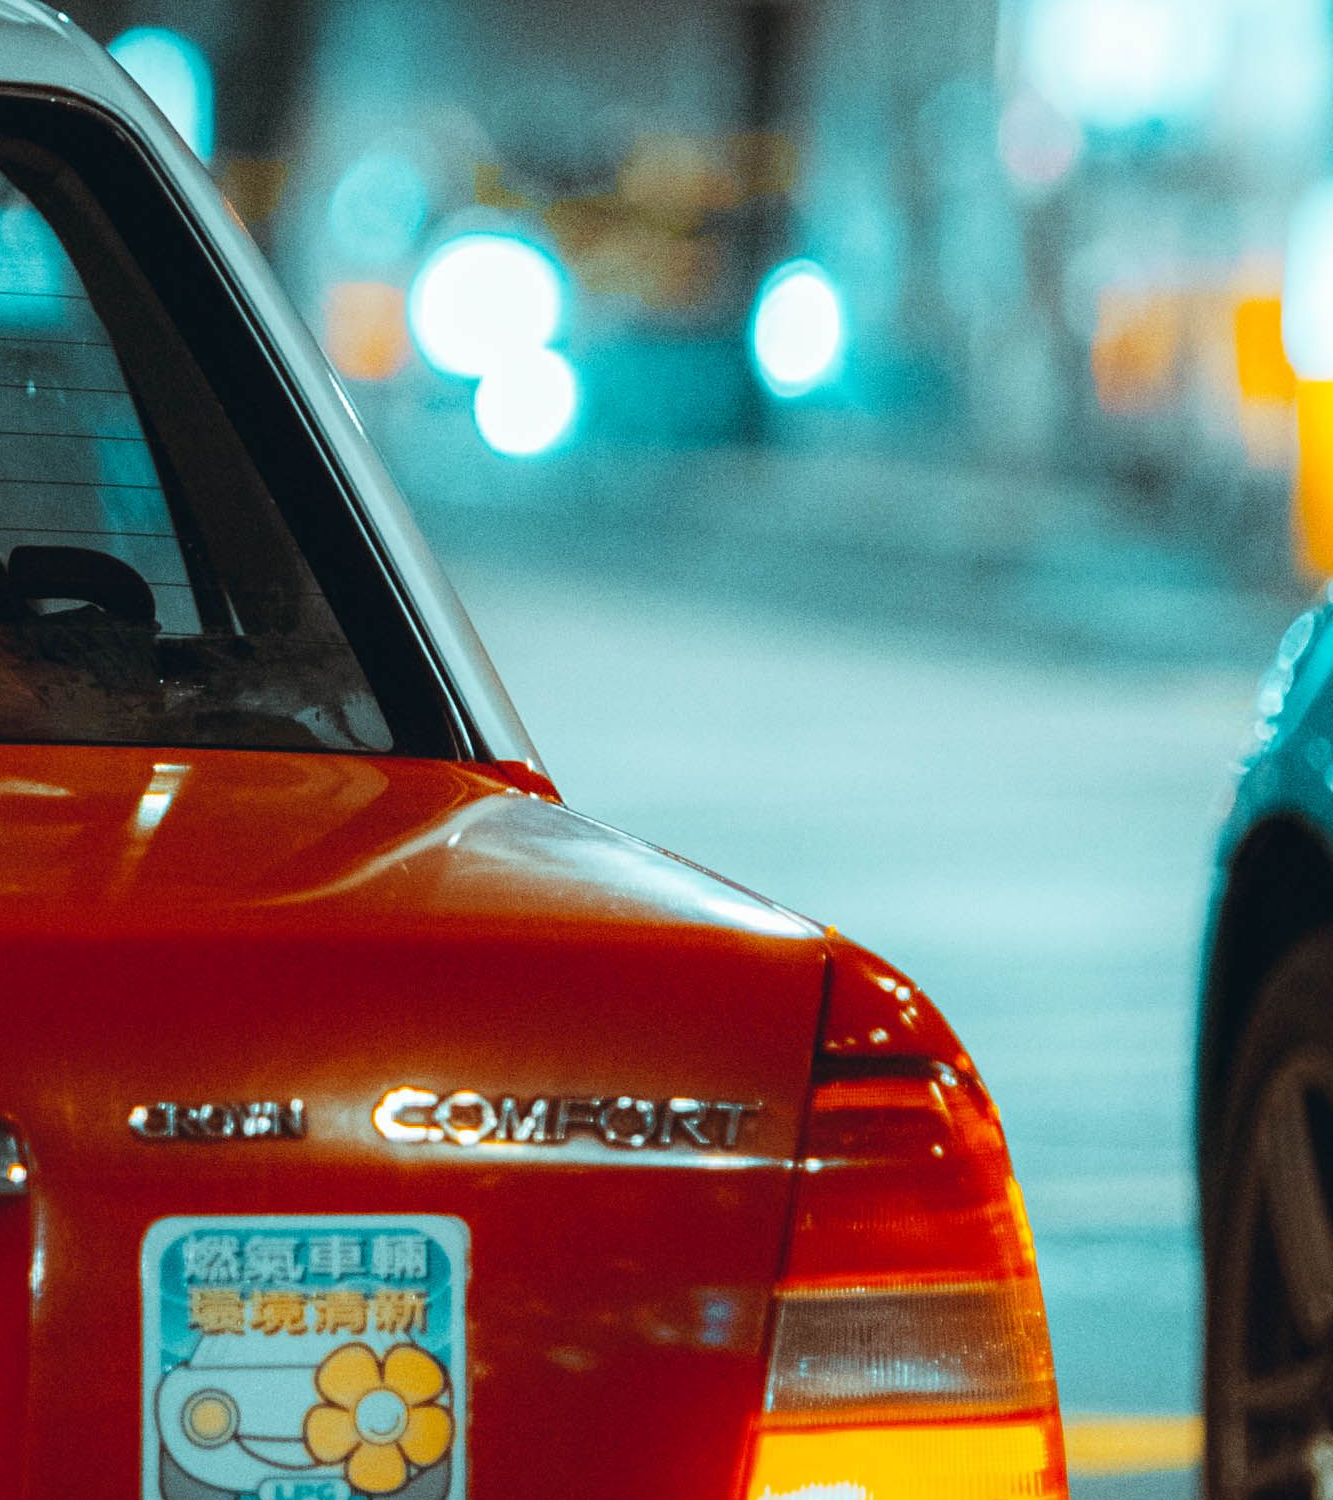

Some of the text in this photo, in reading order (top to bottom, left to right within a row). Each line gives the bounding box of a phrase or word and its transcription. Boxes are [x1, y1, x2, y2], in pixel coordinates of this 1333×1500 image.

[128, 1085, 763, 1149] CROWN COMFORT
[183, 1233, 431, 1284] 燃氣車輛
